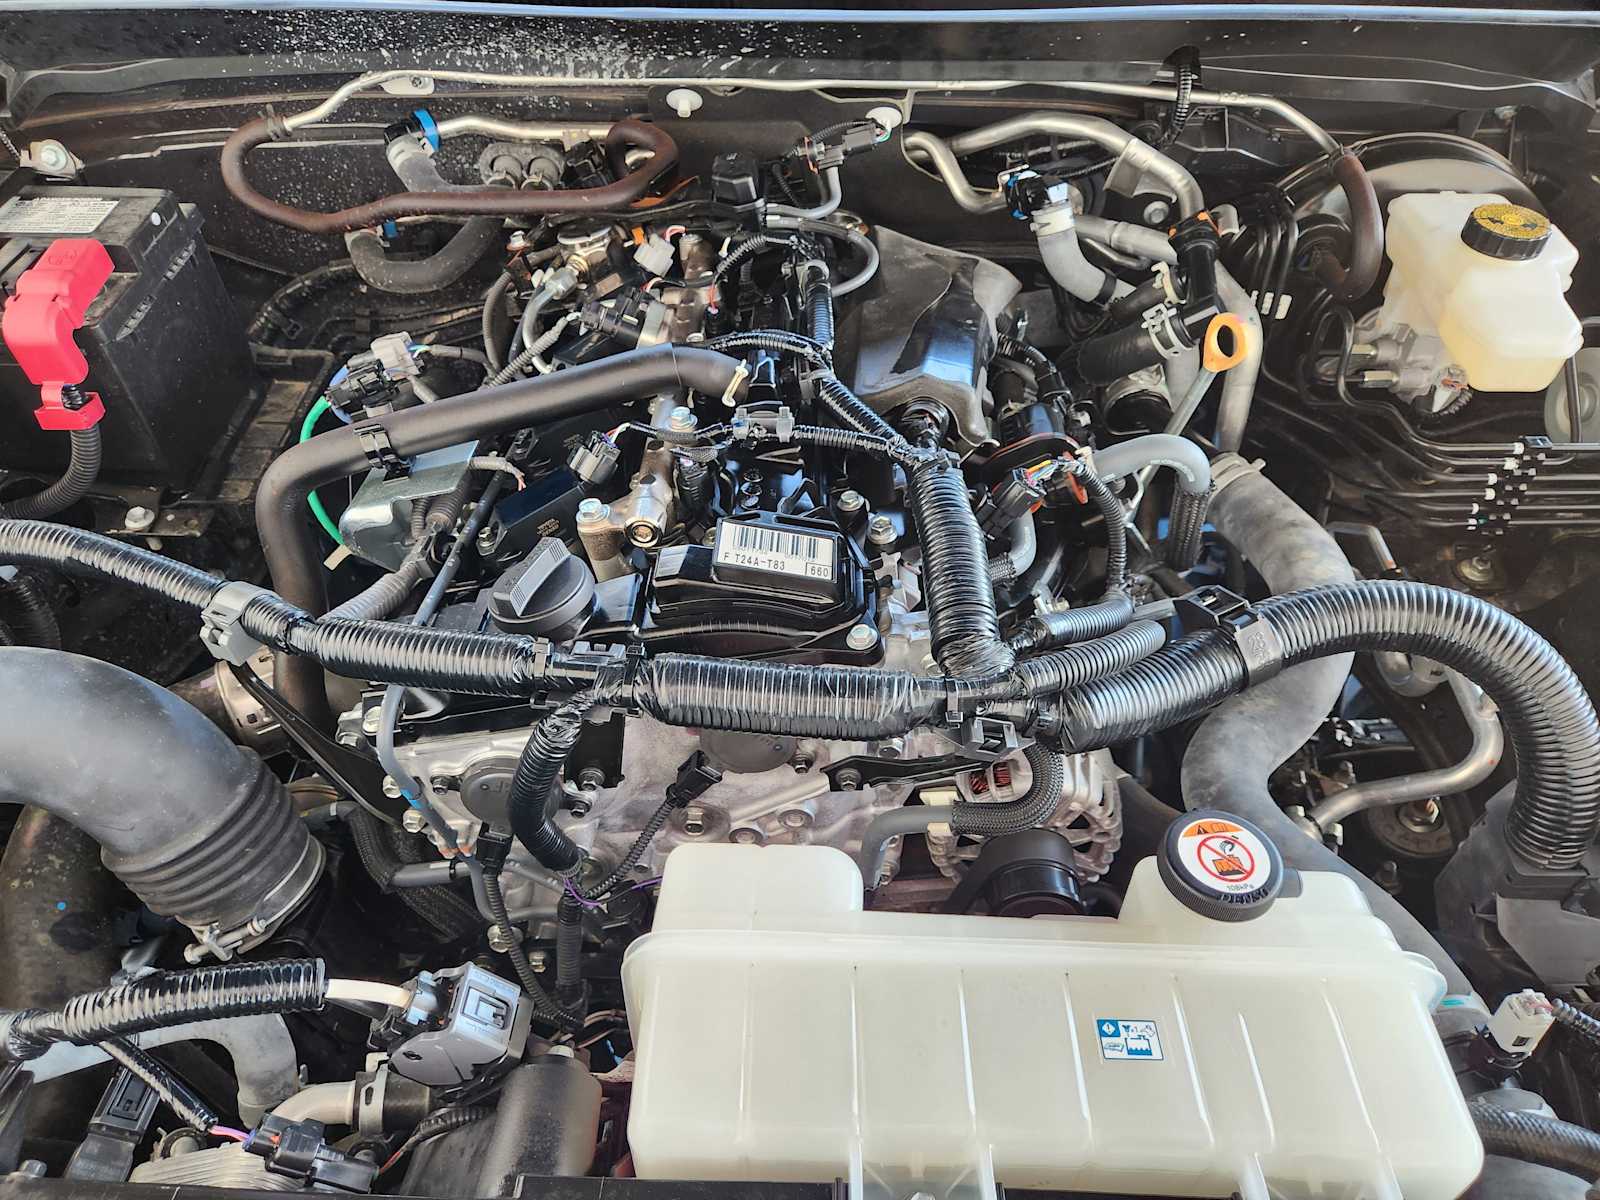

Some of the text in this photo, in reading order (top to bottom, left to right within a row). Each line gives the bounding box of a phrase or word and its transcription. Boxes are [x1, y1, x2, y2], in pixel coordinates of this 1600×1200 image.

[723, 552, 729, 561] F
[735, 553, 785, 571] T24A-T83
[810, 566, 829, 577] 660
